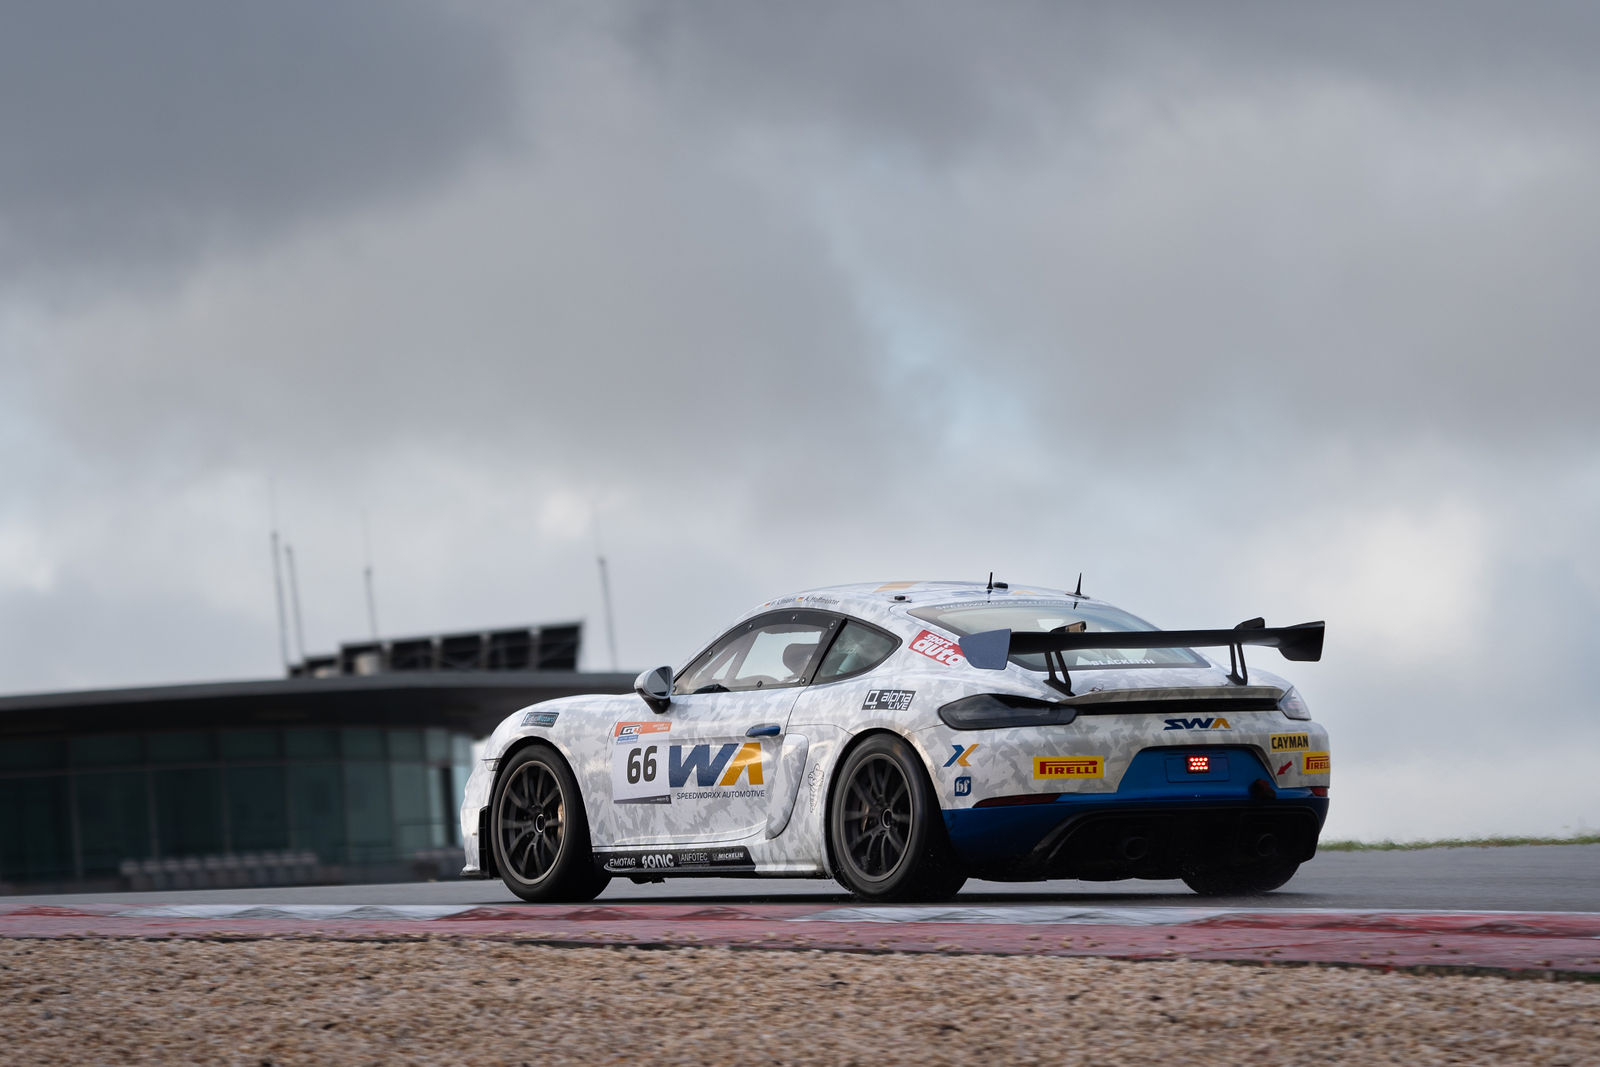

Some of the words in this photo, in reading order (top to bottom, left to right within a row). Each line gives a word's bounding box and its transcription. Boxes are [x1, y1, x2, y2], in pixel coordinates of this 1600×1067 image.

[912, 640, 966, 667] auto
[881, 690, 913, 705] alpha
[888, 702, 910, 711] LIVE
[1163, 717, 1232, 731] SWA
[1271, 735, 1310, 750] CAYMAN
[626, 745, 658, 785] 66
[1039, 760, 1098, 775] PIRELLI
[676, 791, 721, 800] SPEEDWORXX
[721, 789, 765, 798] AUTOMOTIVE
[609, 857, 636, 867] EMOTAG
